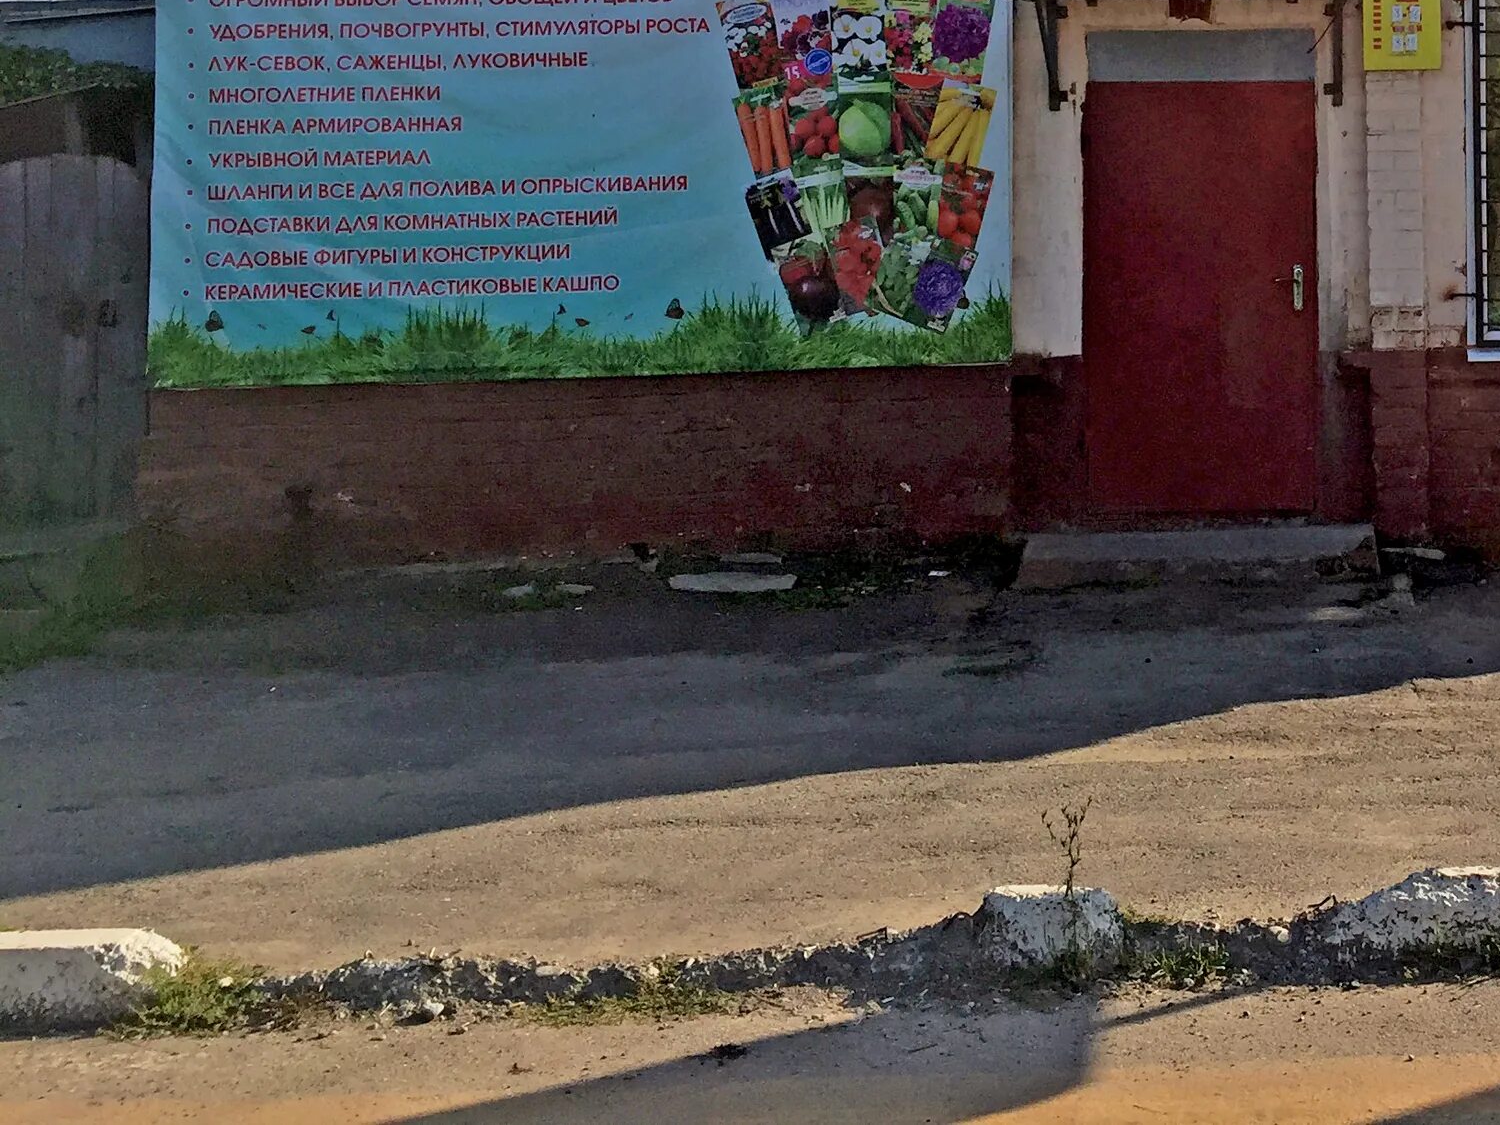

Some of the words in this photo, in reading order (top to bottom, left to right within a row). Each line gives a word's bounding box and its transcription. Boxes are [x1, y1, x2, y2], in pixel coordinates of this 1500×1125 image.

[209, 22, 334, 42] УДОБРЕНИЯ,
[340, 21, 489, 39] ПОЧВОГРУНТЫ,
[496, 19, 640, 36] СТИМУЛЯТОРЫ
[647, 18, 709, 34] РОСТА
[209, 55, 331, 73] ЛУК-СЕВОК,
[337, 54, 447, 72] САЖЕНЦЫ,
[453, 52, 588, 68] ЛУКОВИЧНЫЕ
[209, 86, 356, 104] МНОГОЛЕТНИЕ
[362, 86, 440, 102] ПЛЕНКИ
[209, 118, 286, 135] ПЛЕНКА
[291, 116, 462, 134] АРМИРОВАННАЯ
[209, 148, 318, 169] УКРЫВНОЙ
[324, 150, 431, 167] МАТЕРИАЛ
[208, 184, 292, 200] ШЛАНГИ
[299, 183, 312, 199] И
[319, 182, 355, 199] ВСЕ
[360, 181, 403, 200] ДЛЯ
[410, 180, 495, 197] ПОЛИВА
[501, 179, 515, 195] И
[521, 176, 687, 194] ОПРЫСКИВАНИЯ
[208, 216, 330, 236] ПОДСТАВКИ
[335, 215, 378, 233] ДЛЯ
[384, 212, 511, 230] КОМНАТНЫХ
[516, 207, 618, 227] РАСТЕНИЙ
[206, 250, 308, 270] САДОВЫЕ
[313, 248, 397, 267] ФИГУРЫ
[403, 248, 417, 264] И
[422, 244, 570, 264] КОНСТРУКЦИИ
[205, 283, 362, 301] КЕРАМИЧЕСКИЕ
[368, 282, 383, 298] И
[388, 279, 537, 297] ПЛАСТИКОВЫЕ
[543, 275, 620, 293] КАШПО
